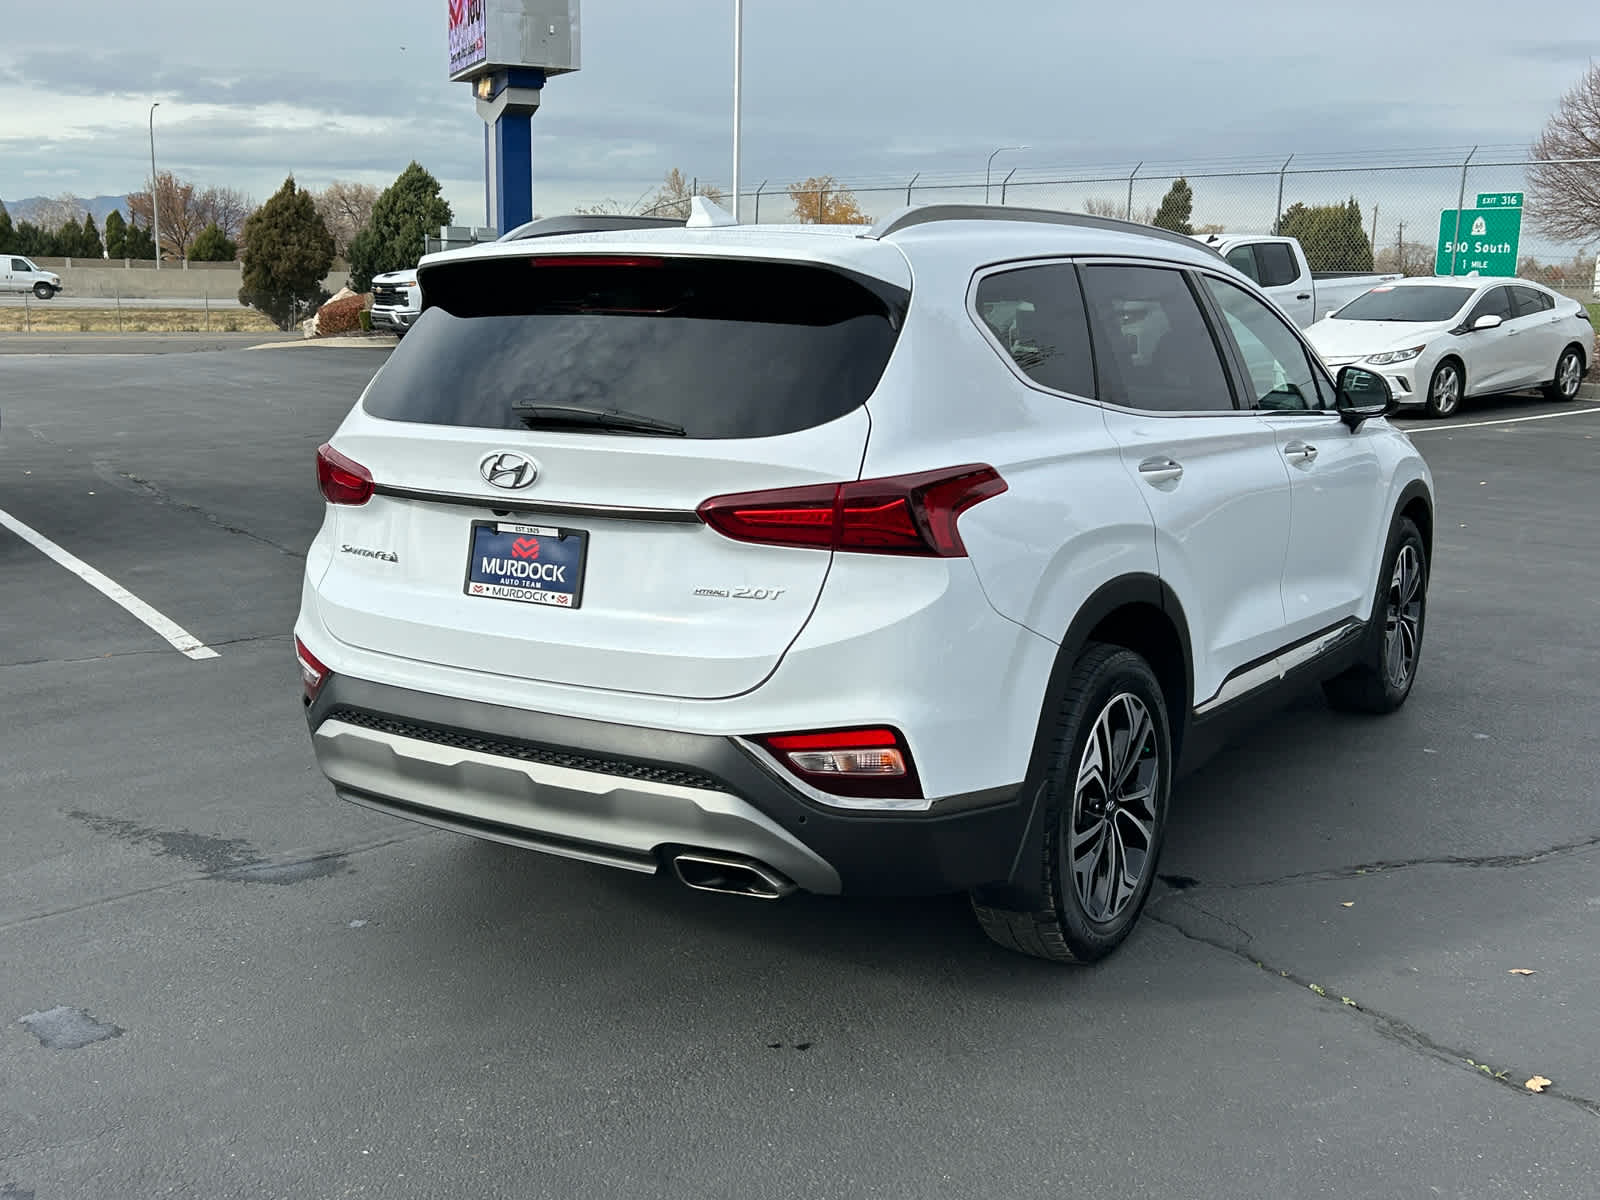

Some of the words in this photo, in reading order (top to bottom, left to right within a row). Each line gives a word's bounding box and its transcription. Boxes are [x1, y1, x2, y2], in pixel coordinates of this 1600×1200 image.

[1482, 197, 1497, 205] EXIT
[1501, 196, 1517, 205] 316
[1474, 241, 1511, 253] South
[1462, 259, 1467, 269] 1
[1471, 260, 1489, 269] MILE
[481, 556, 567, 583] MURDOCK
[500, 577, 520, 587] AUTO
[522, 579, 542, 589] TEAM
[491, 586, 549, 602] MURDOCK
